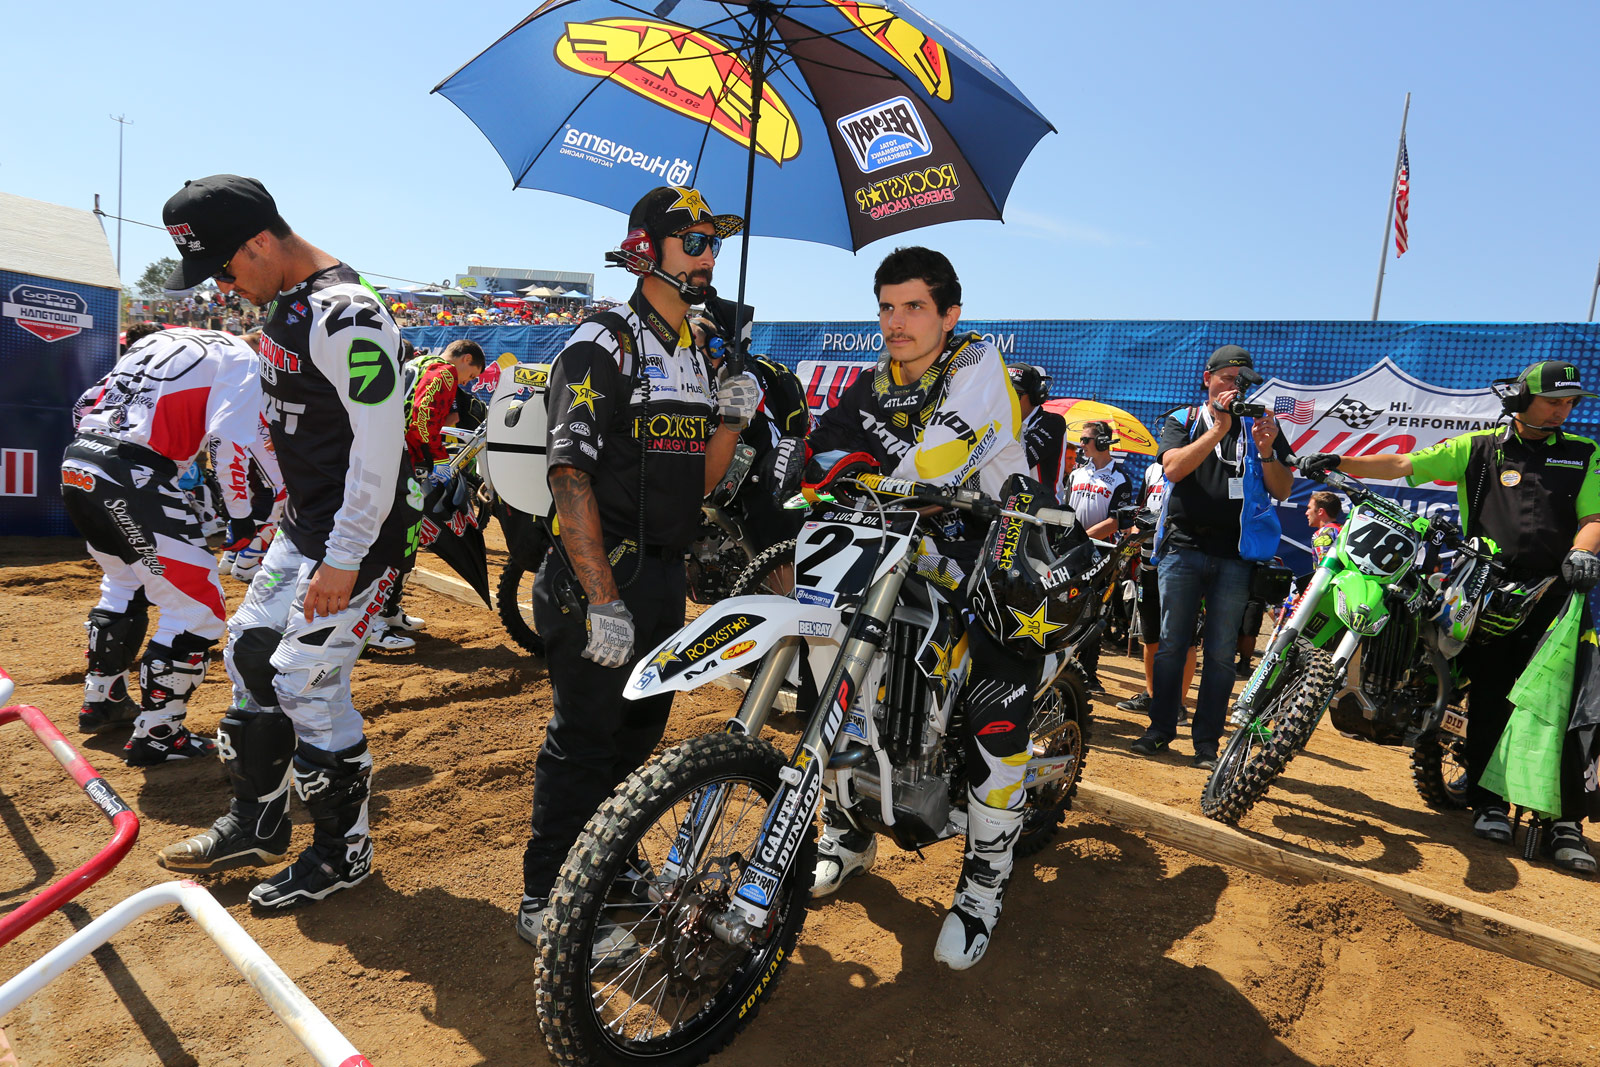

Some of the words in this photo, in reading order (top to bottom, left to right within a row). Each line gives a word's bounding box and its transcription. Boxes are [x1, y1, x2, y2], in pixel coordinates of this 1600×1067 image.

[22, 290, 77, 304] GoPro
[20, 307, 78, 324] HANGTOWN
[322, 294, 384, 337] 22
[884, 395, 918, 408] ATLAS
[930, 411, 977, 452] HOR
[1546, 458, 1583, 466] Kawasaki
[62, 469, 94, 491] BROC
[862, 514, 880, 526] OIL
[1374, 514, 1397, 528] LUCAS
[1396, 526, 1407, 534] OIL
[104, 498, 145, 545] Soaring
[135, 544, 165, 576] Eagle
[994, 533, 1006, 561] DRINK
[1347, 521, 1415, 573] 48
[796, 525, 901, 597] 21
[802, 592, 832, 604] Husqvarna
[722, 640, 756, 659] FMF
[310, 669, 327, 687] SHIFT
[1245, 670, 1268, 703] CARRILLO
[1001, 684, 1028, 708] THOR
[1446, 715, 1463, 729] DID
[761, 788, 798, 863] GALFER
[777, 774, 820, 871] DUNLOP
[738, 946, 785, 1020] DUNLOP
